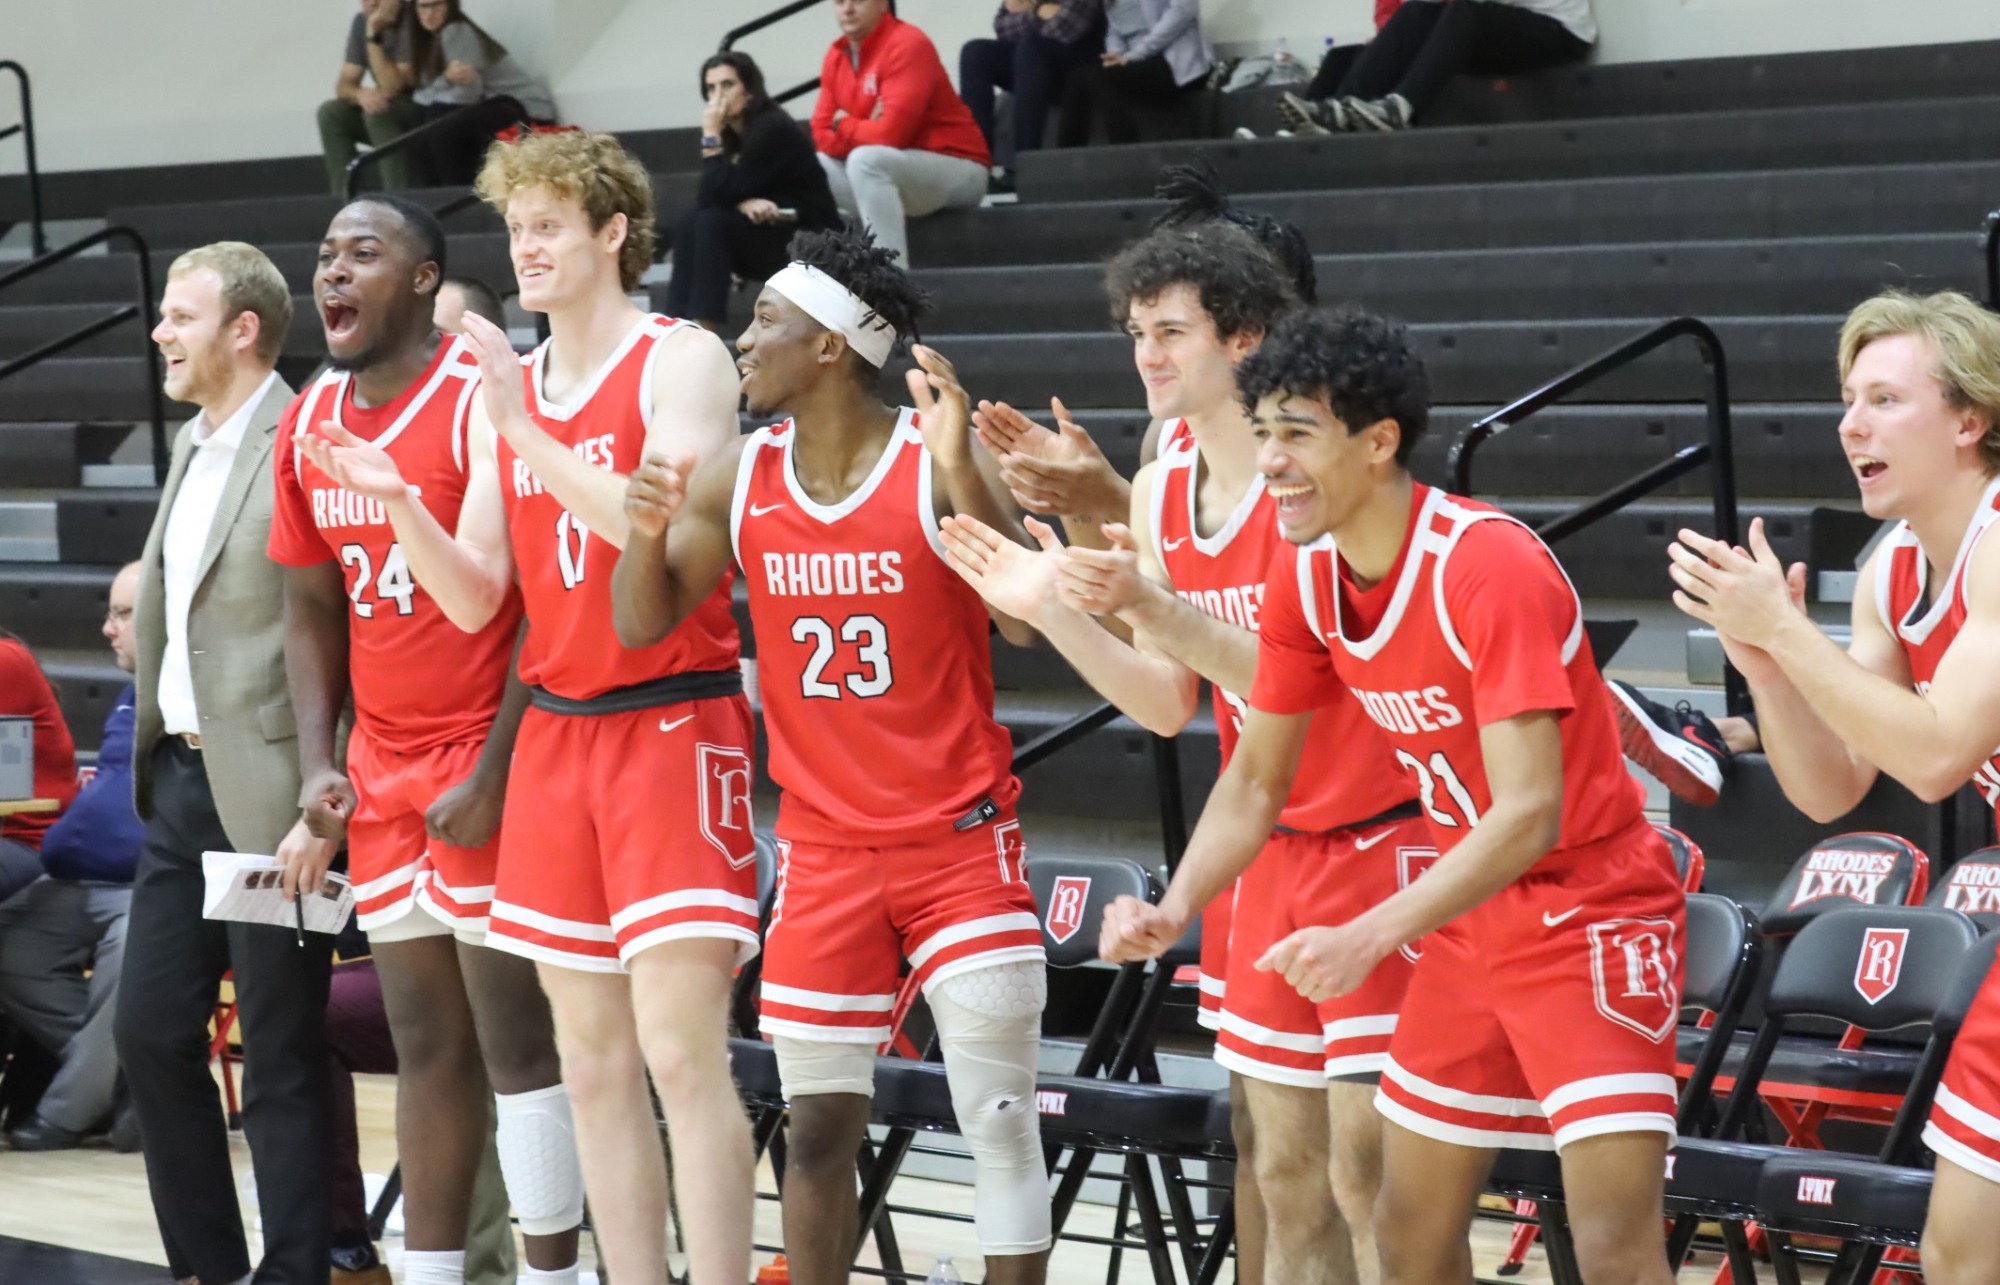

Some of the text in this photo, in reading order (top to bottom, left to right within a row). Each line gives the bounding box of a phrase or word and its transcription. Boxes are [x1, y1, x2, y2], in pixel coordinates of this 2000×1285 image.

[311, 484, 422, 529] RHOD
[340, 542, 416, 619] 24
[763, 551, 904, 596] RHODES
[791, 614, 894, 699] 23
[1395, 747, 1480, 829] 21
[1806, 850, 1897, 874] RHODES
[1951, 864, 2000, 887] RHO
[1788, 870, 1888, 911] LYNX
[1797, 1175, 1837, 1205] LYNX
